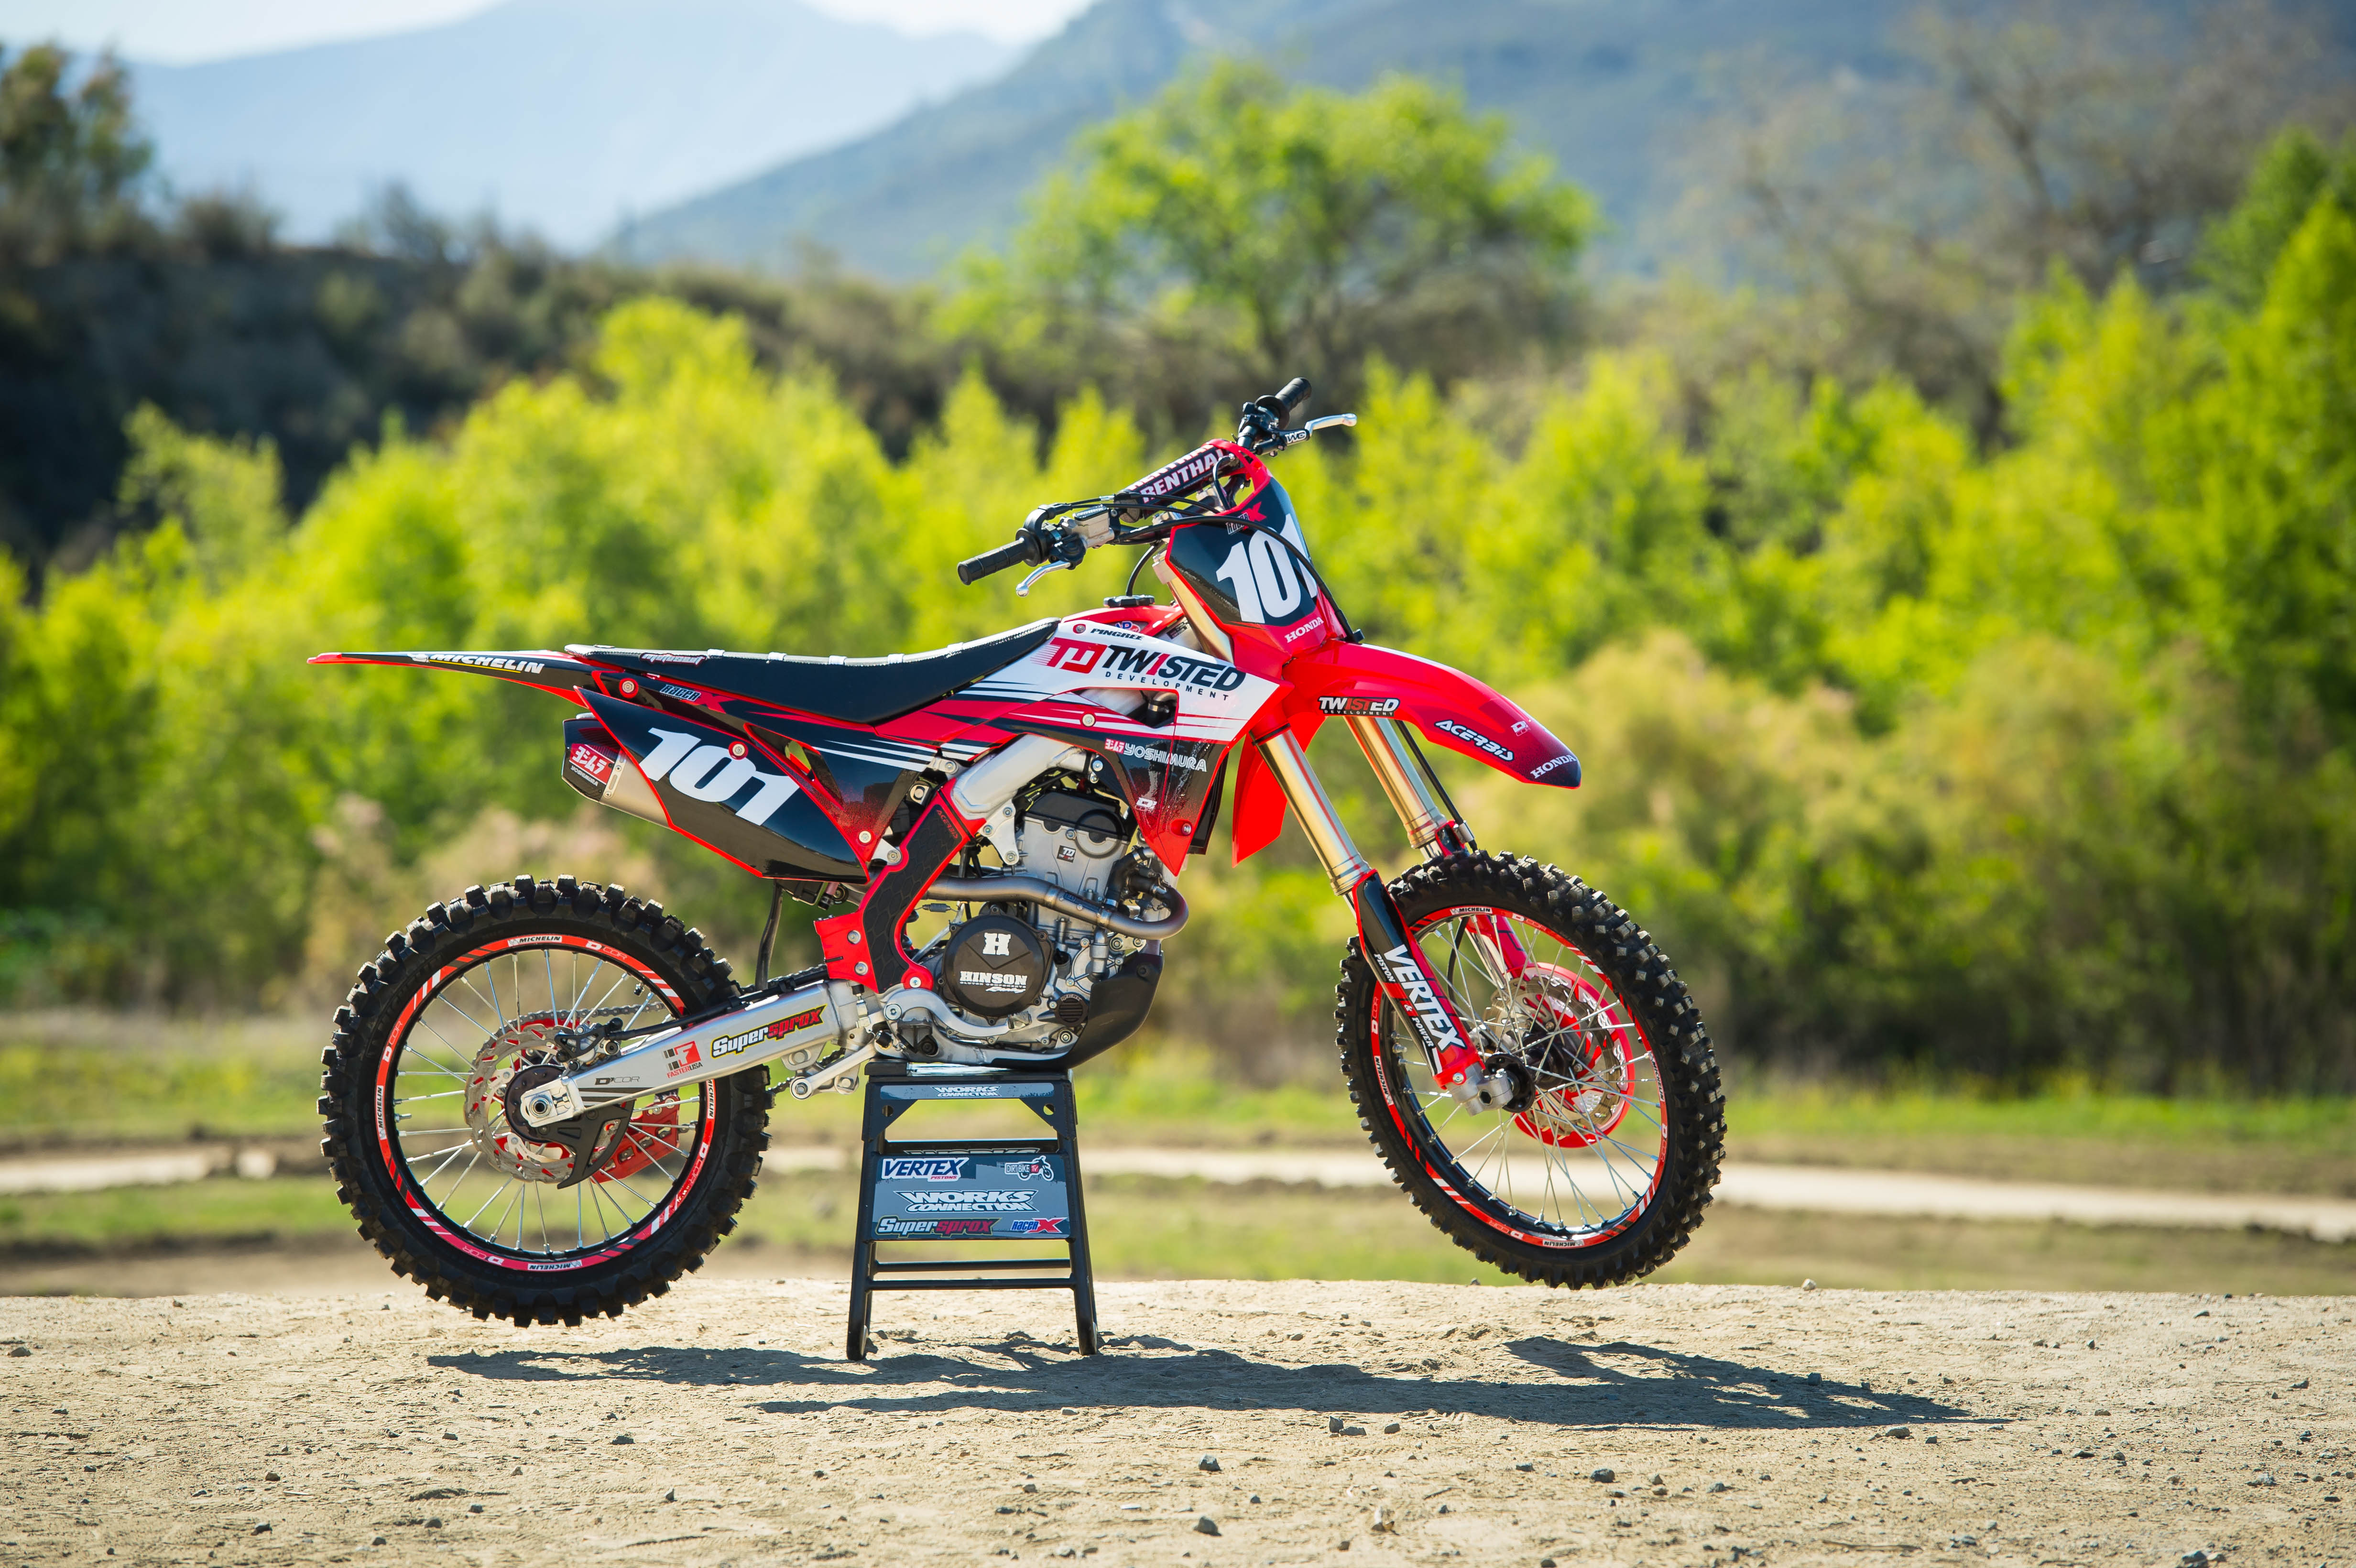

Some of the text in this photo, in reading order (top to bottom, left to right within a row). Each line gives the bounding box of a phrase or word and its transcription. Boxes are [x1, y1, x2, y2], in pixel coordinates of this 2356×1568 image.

[1090, 628, 1145, 641] PINGREE
[1284, 617, 1324, 643] HONDA
[430, 653, 545, 674] MICHELIN
[1105, 672, 1229, 701] DEVELOPMENT
[1319, 697, 1399, 712] TWISTED
[1435, 720, 1513, 761] ACERBIS
[1123, 743, 1207, 772] YOSHIMURA
[1530, 754, 1577, 779] HONDA
[639, 727, 800, 826] 101
[983, 932, 1011, 956] H
[960, 971, 1027, 985] HINSON
[1374, 954, 1396, 982] PISTON
[1412, 1017, 1434, 1047] POWER
[1384, 945, 1466, 1051] VERTEX
[1375, 1056, 1388, 1094] MICHELIN
[884, 1160, 965, 1176] VERTEX
[1006, 1165, 1018, 1173] DIRT
[1018, 1165, 1030, 1173] BIKE
[901, 1191, 1034, 1203] WORKS
[907, 1202, 1034, 1211] CONNECTION
